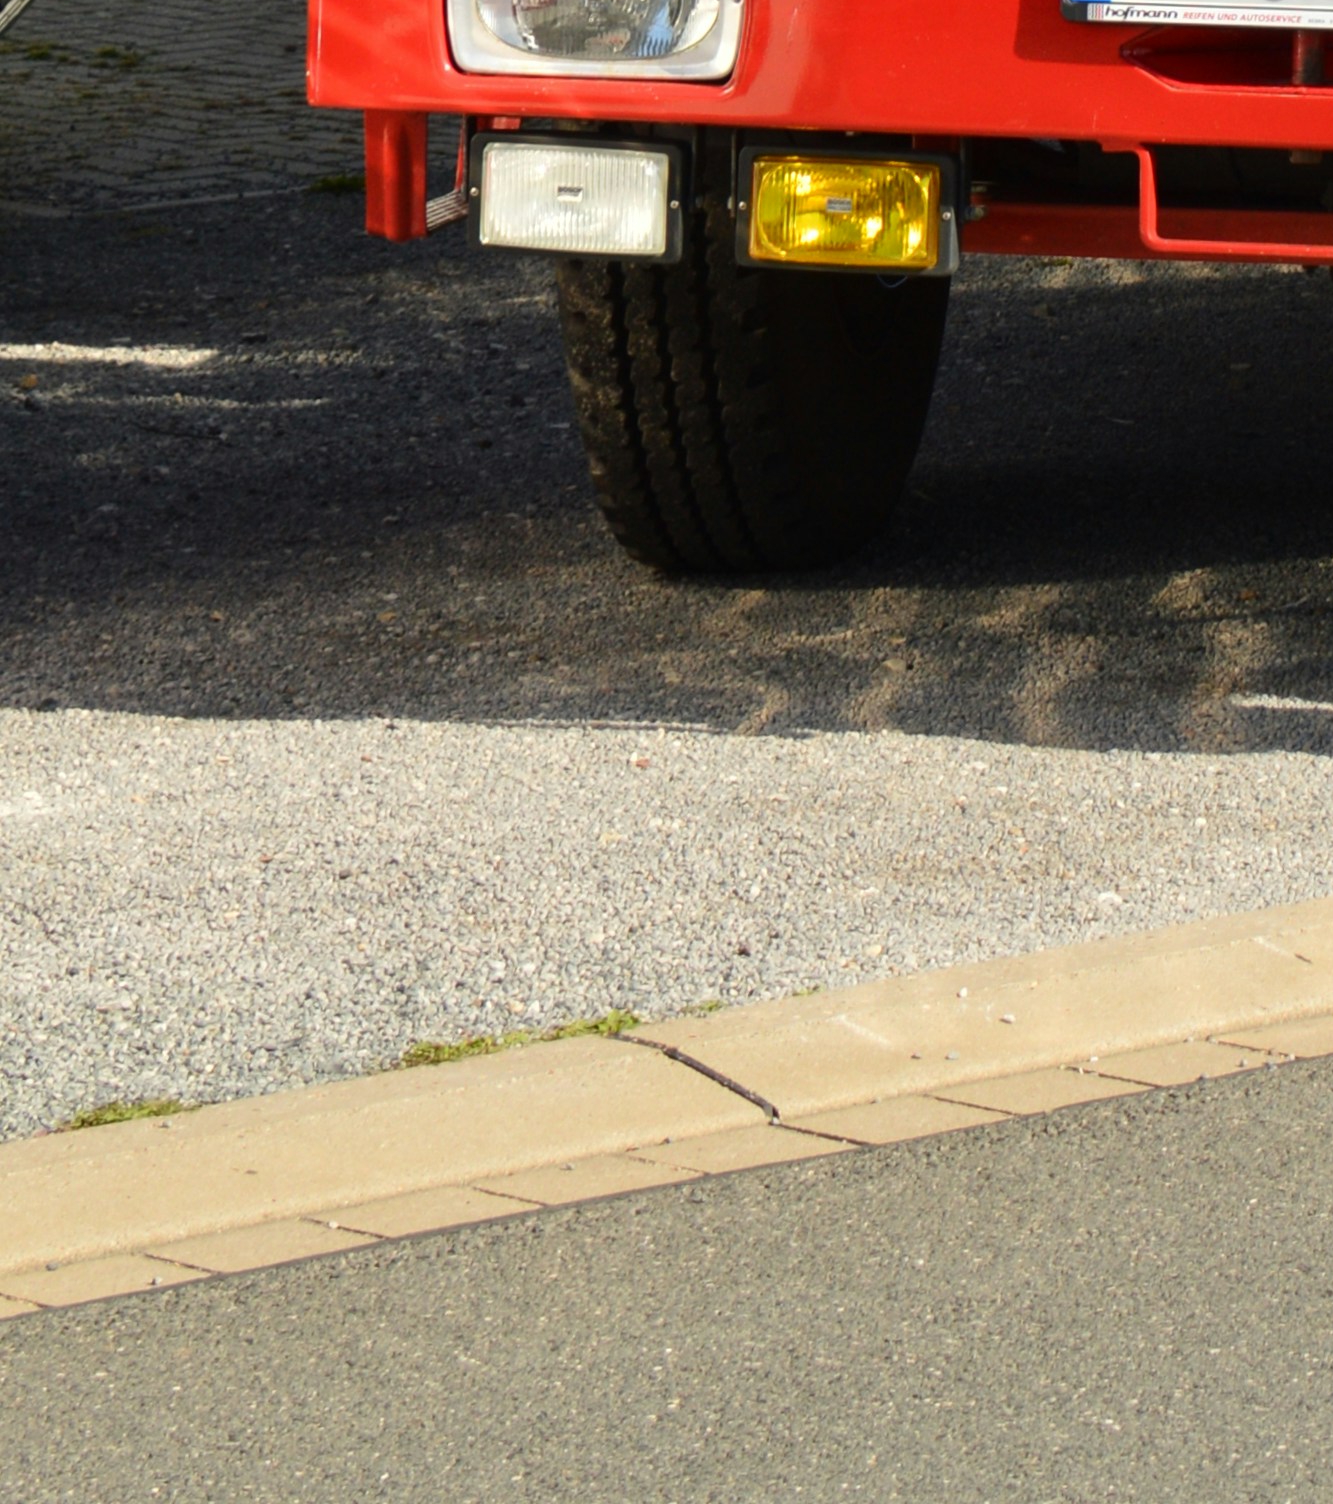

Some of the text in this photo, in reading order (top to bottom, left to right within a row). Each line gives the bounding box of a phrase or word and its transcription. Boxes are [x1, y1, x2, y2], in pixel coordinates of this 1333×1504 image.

[1105, 6, 1178, 20] hofmann
[1183, 11, 1215, 21] REIFEN
[1217, 13, 1238, 22] UND
[1239, 13, 1302, 24] AUTOSERVICE
